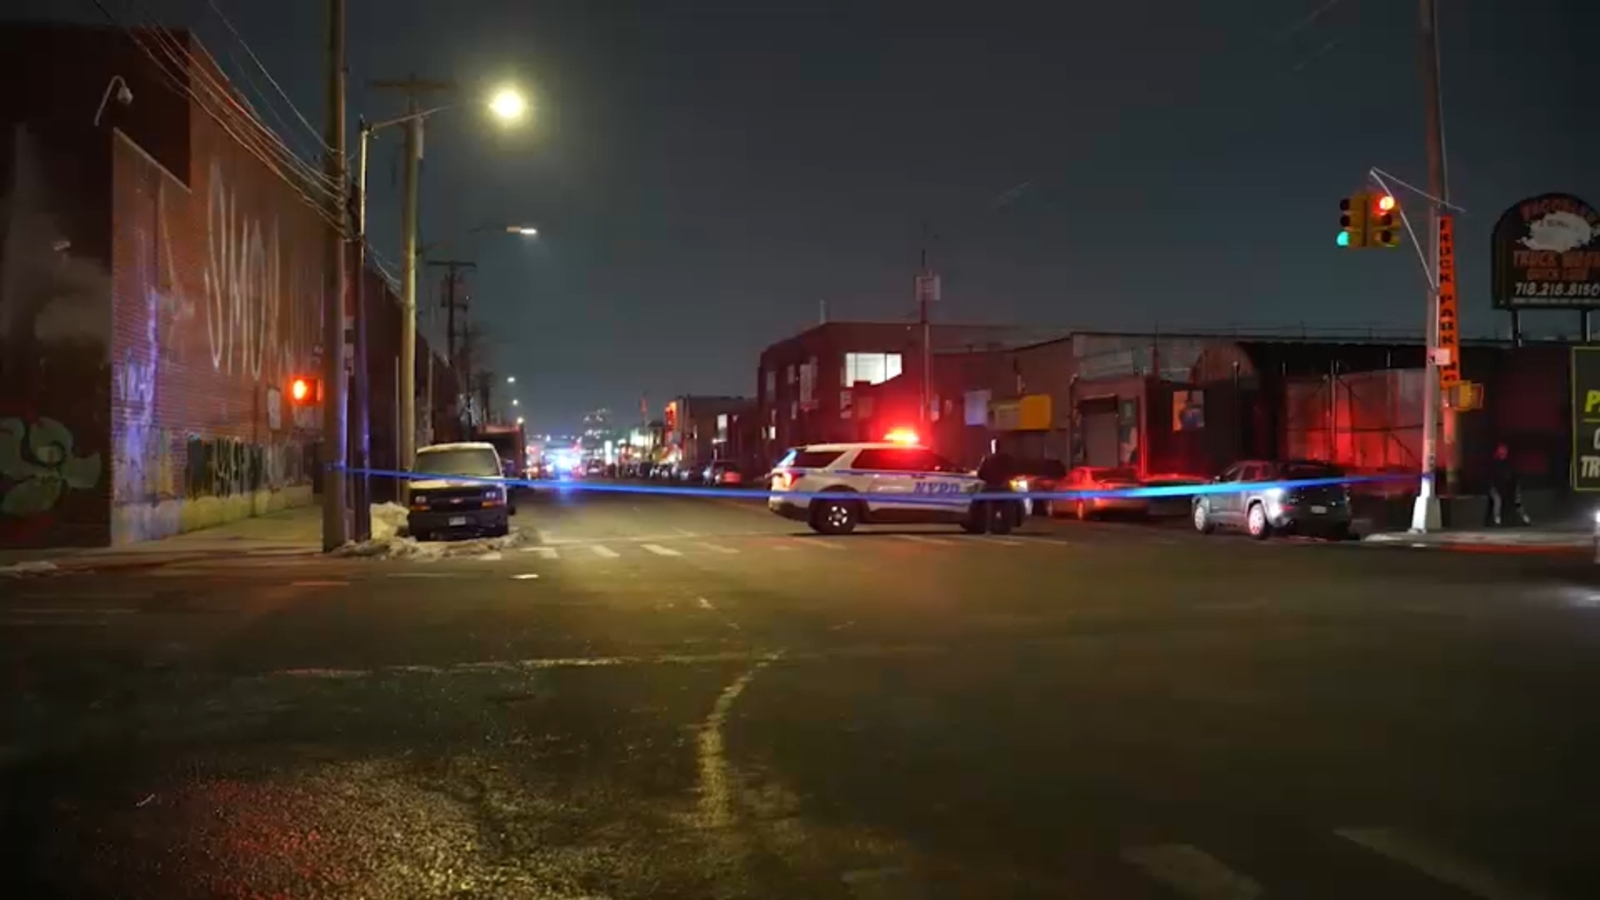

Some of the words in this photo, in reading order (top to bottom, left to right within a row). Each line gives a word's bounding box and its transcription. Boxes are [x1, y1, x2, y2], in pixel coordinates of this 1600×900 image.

[1513, 250, 1555, 267] TRUCK
[1440, 294, 1457, 382] PARKNG
[1584, 389, 1600, 413] P
[913, 481, 961, 496] NYPD
